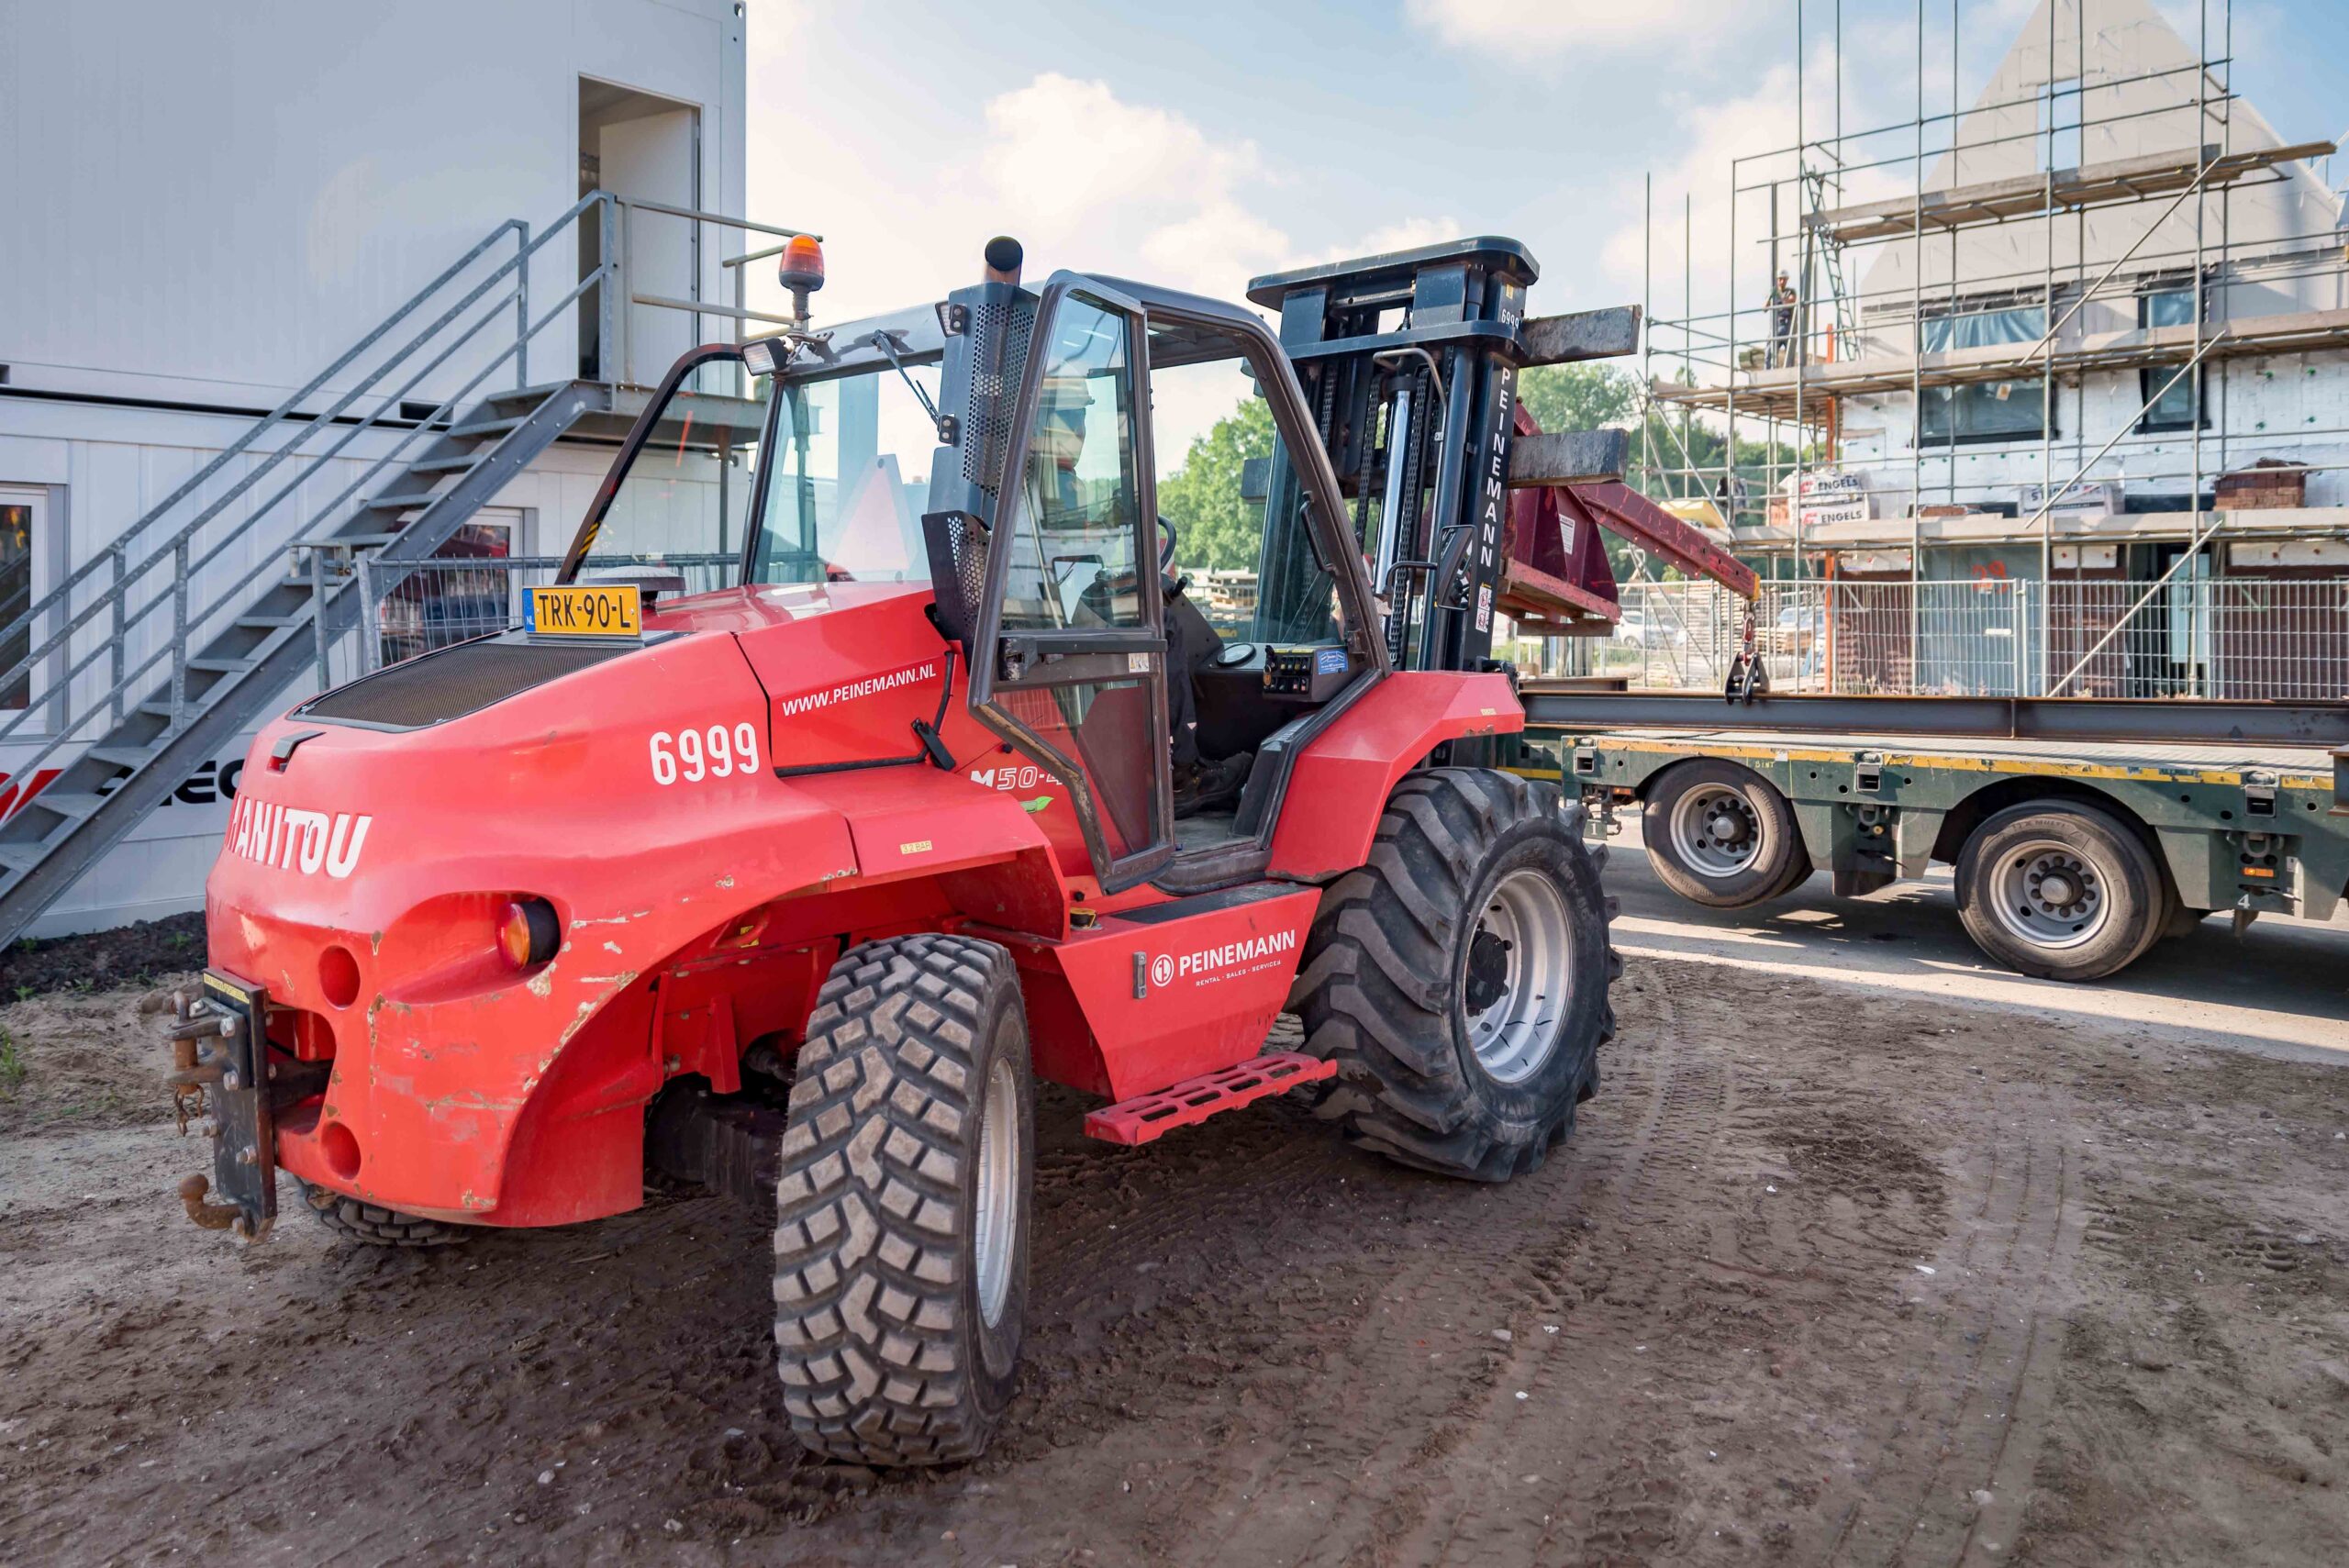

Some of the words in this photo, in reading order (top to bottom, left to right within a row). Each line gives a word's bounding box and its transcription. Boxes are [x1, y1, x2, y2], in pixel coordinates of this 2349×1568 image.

[1501, 308, 1520, 329] 6999
[1480, 366, 1511, 567] PEINEMANN
[1818, 477, 1858, 491] ENGELS
[1821, 510, 1863, 524] ENGELS
[526, 616, 535, 625] NL
[538, 594, 631, 628] TRK-90-L
[782, 663, 937, 717] WWW.PEINEMANN.NL
[649, 722, 760, 785] 6999
[1590, 822, 1598, 836] 1
[2237, 894, 2251, 909] 4
[1179, 929, 1296, 976] PEINEMANN
[1196, 976, 1221, 987] RENTAL
[1226, 969, 1247, 979] SALES
[1252, 960, 1281, 973] SERVICES
